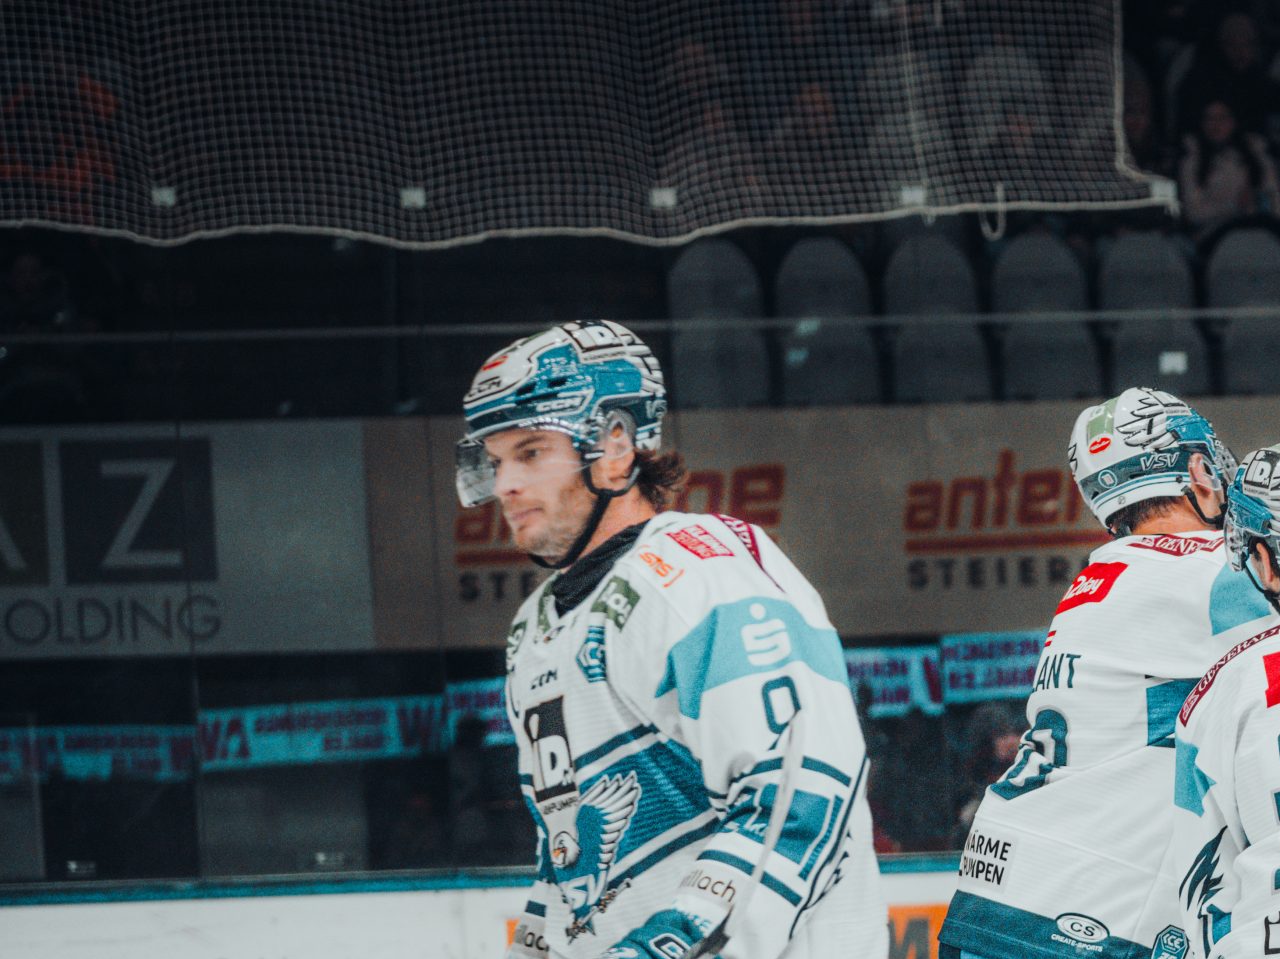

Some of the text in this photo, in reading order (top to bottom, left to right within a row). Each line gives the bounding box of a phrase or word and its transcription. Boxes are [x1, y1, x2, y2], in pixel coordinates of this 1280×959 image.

[535, 397, 581, 412] CCM
[1140, 452, 1181, 471] VSV
[1070, 921, 1096, 937] CS
